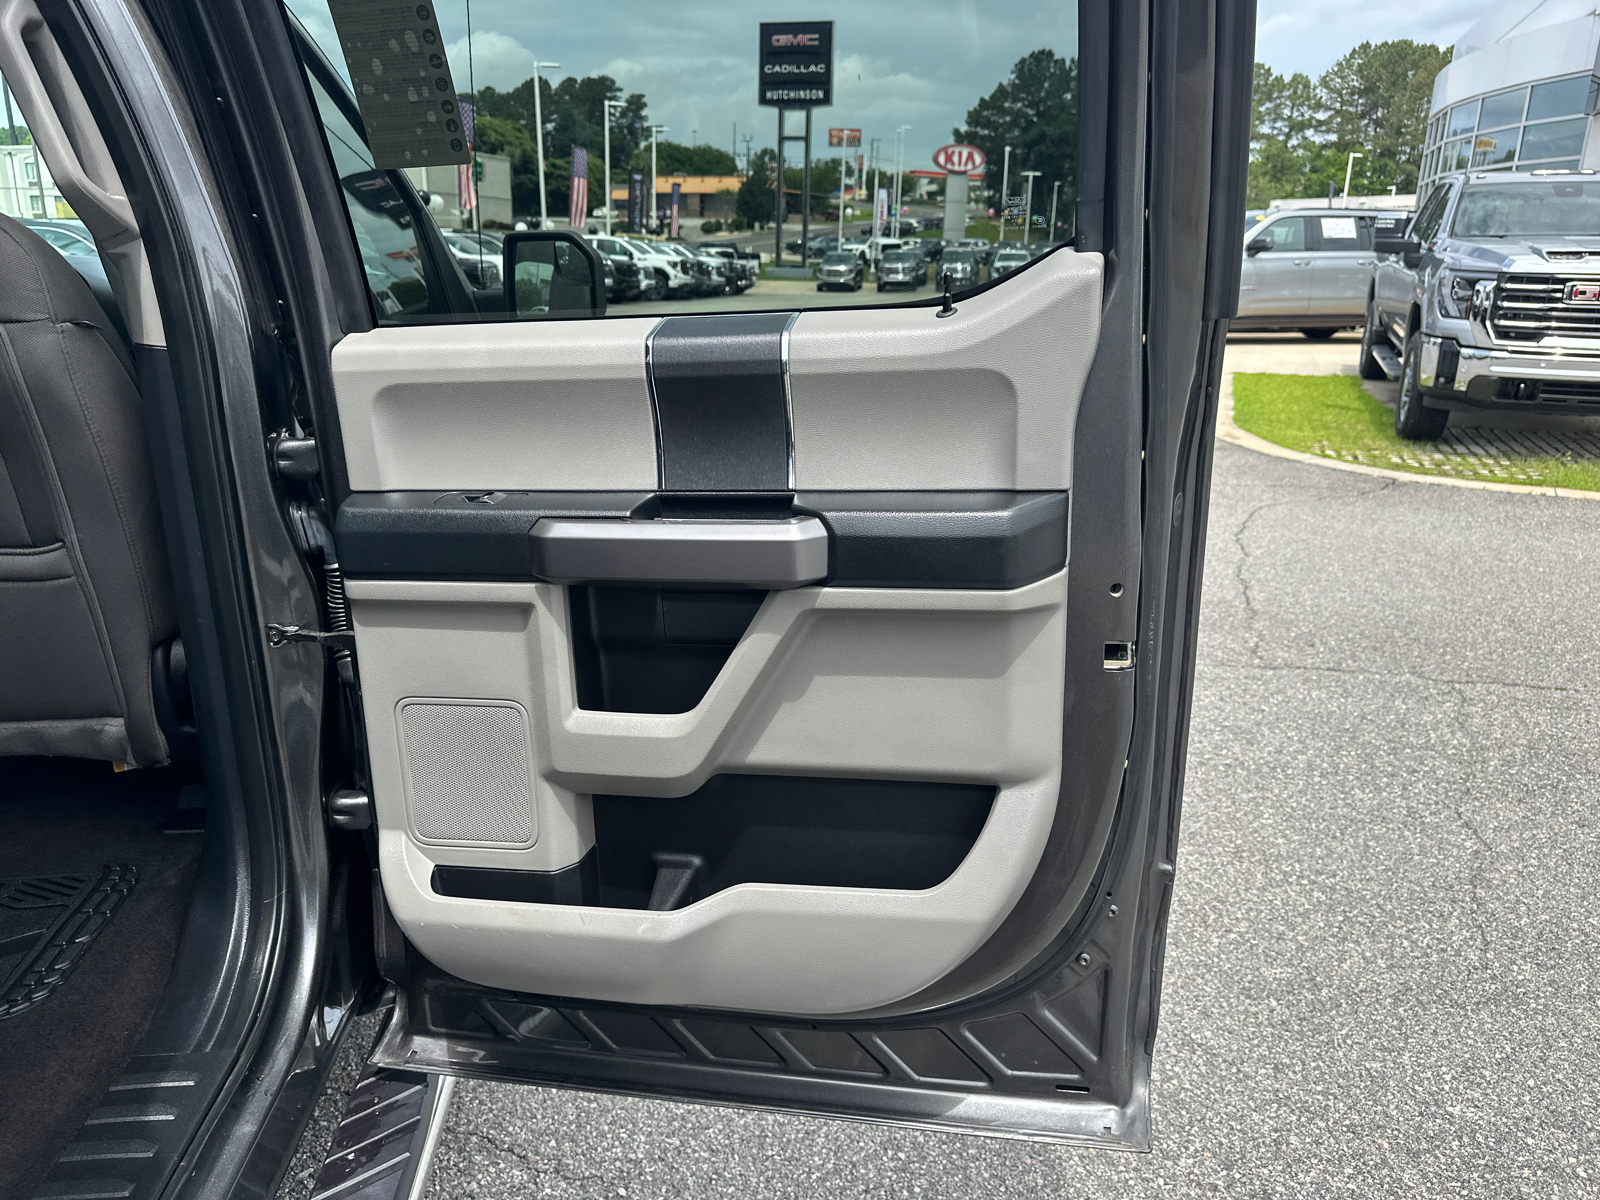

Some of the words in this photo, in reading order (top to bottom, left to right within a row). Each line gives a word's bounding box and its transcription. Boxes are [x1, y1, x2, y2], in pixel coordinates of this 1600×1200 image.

[771, 34, 820, 47] GMC
[764, 64, 826, 73] CADILLAC
[766, 89, 825, 100] HUTCHINSON
[944, 150, 977, 169] KIA
